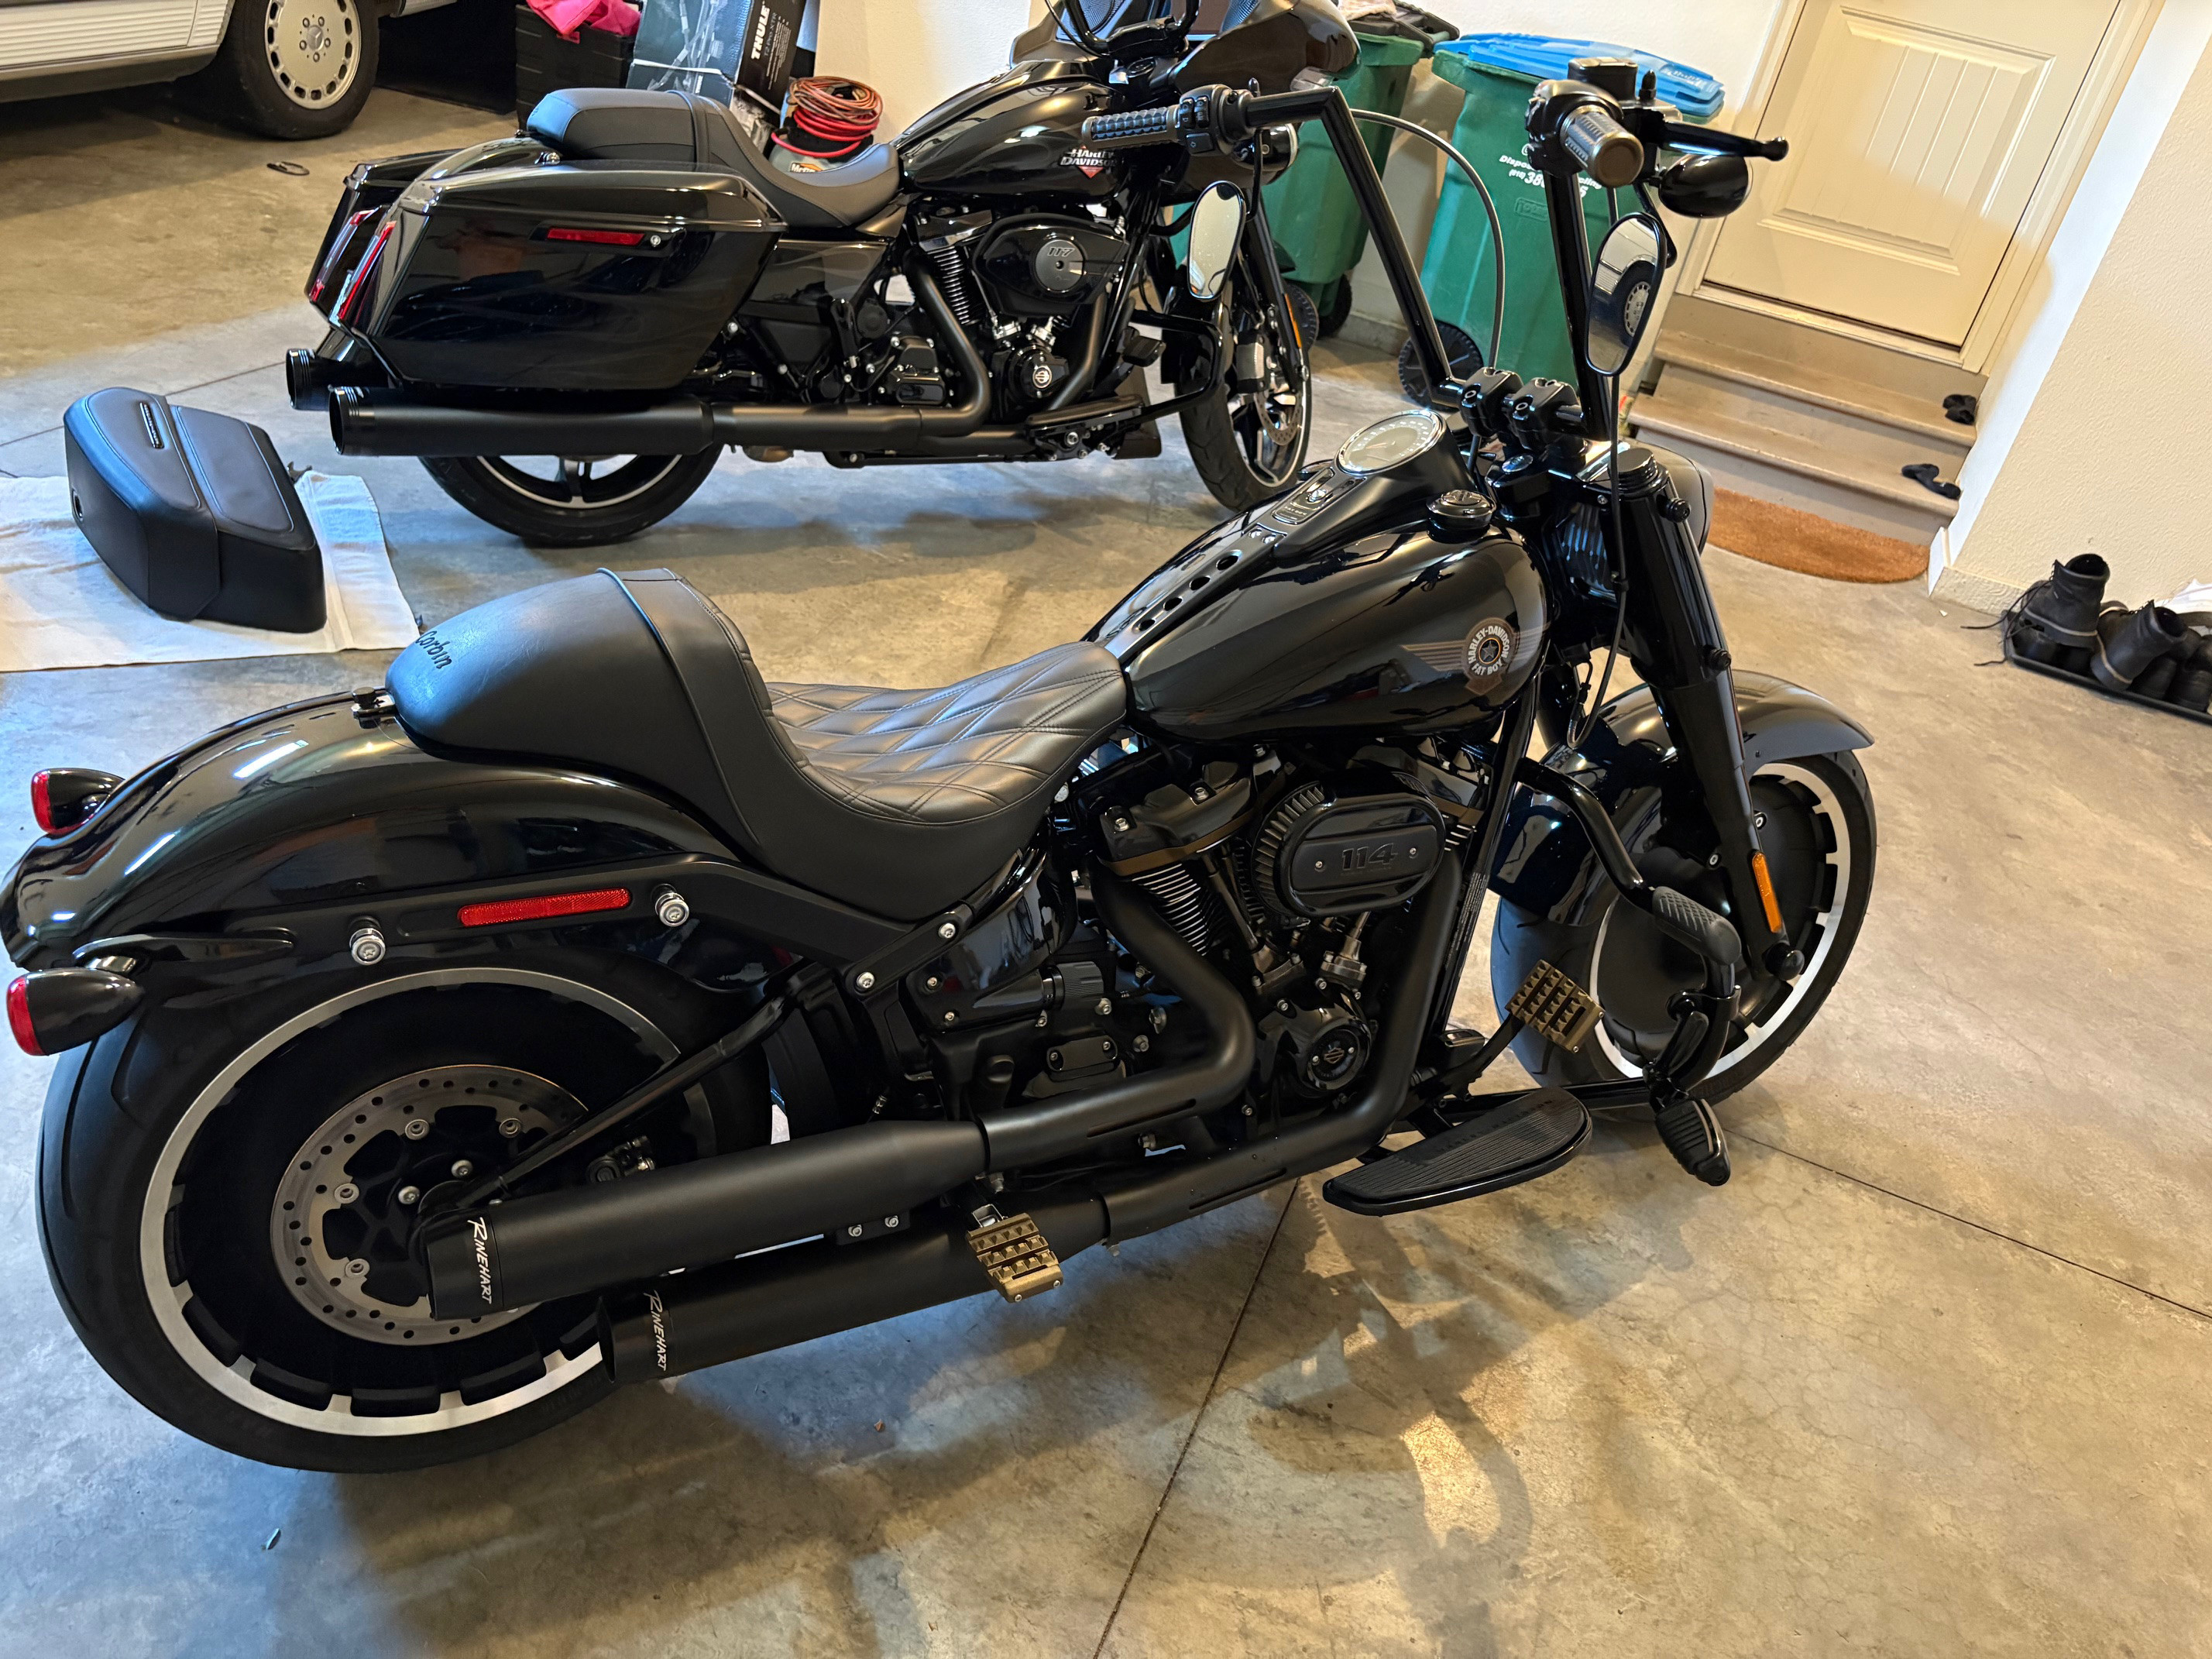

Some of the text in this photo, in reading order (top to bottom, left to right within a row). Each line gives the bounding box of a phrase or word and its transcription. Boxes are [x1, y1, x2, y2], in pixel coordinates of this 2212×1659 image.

[750, 5, 771, 60] THULE
[1046, 246, 1076, 257] 117
[415, 630, 452, 669] Corbin
[1468, 625, 1510, 664] HARLEY-DAVIDSON
[1472, 658, 1503, 676] FAT BOY
[1341, 843, 1399, 871] 114
[467, 1217, 493, 1305] RINEHART
[644, 1290, 668, 1372] RINEHART
